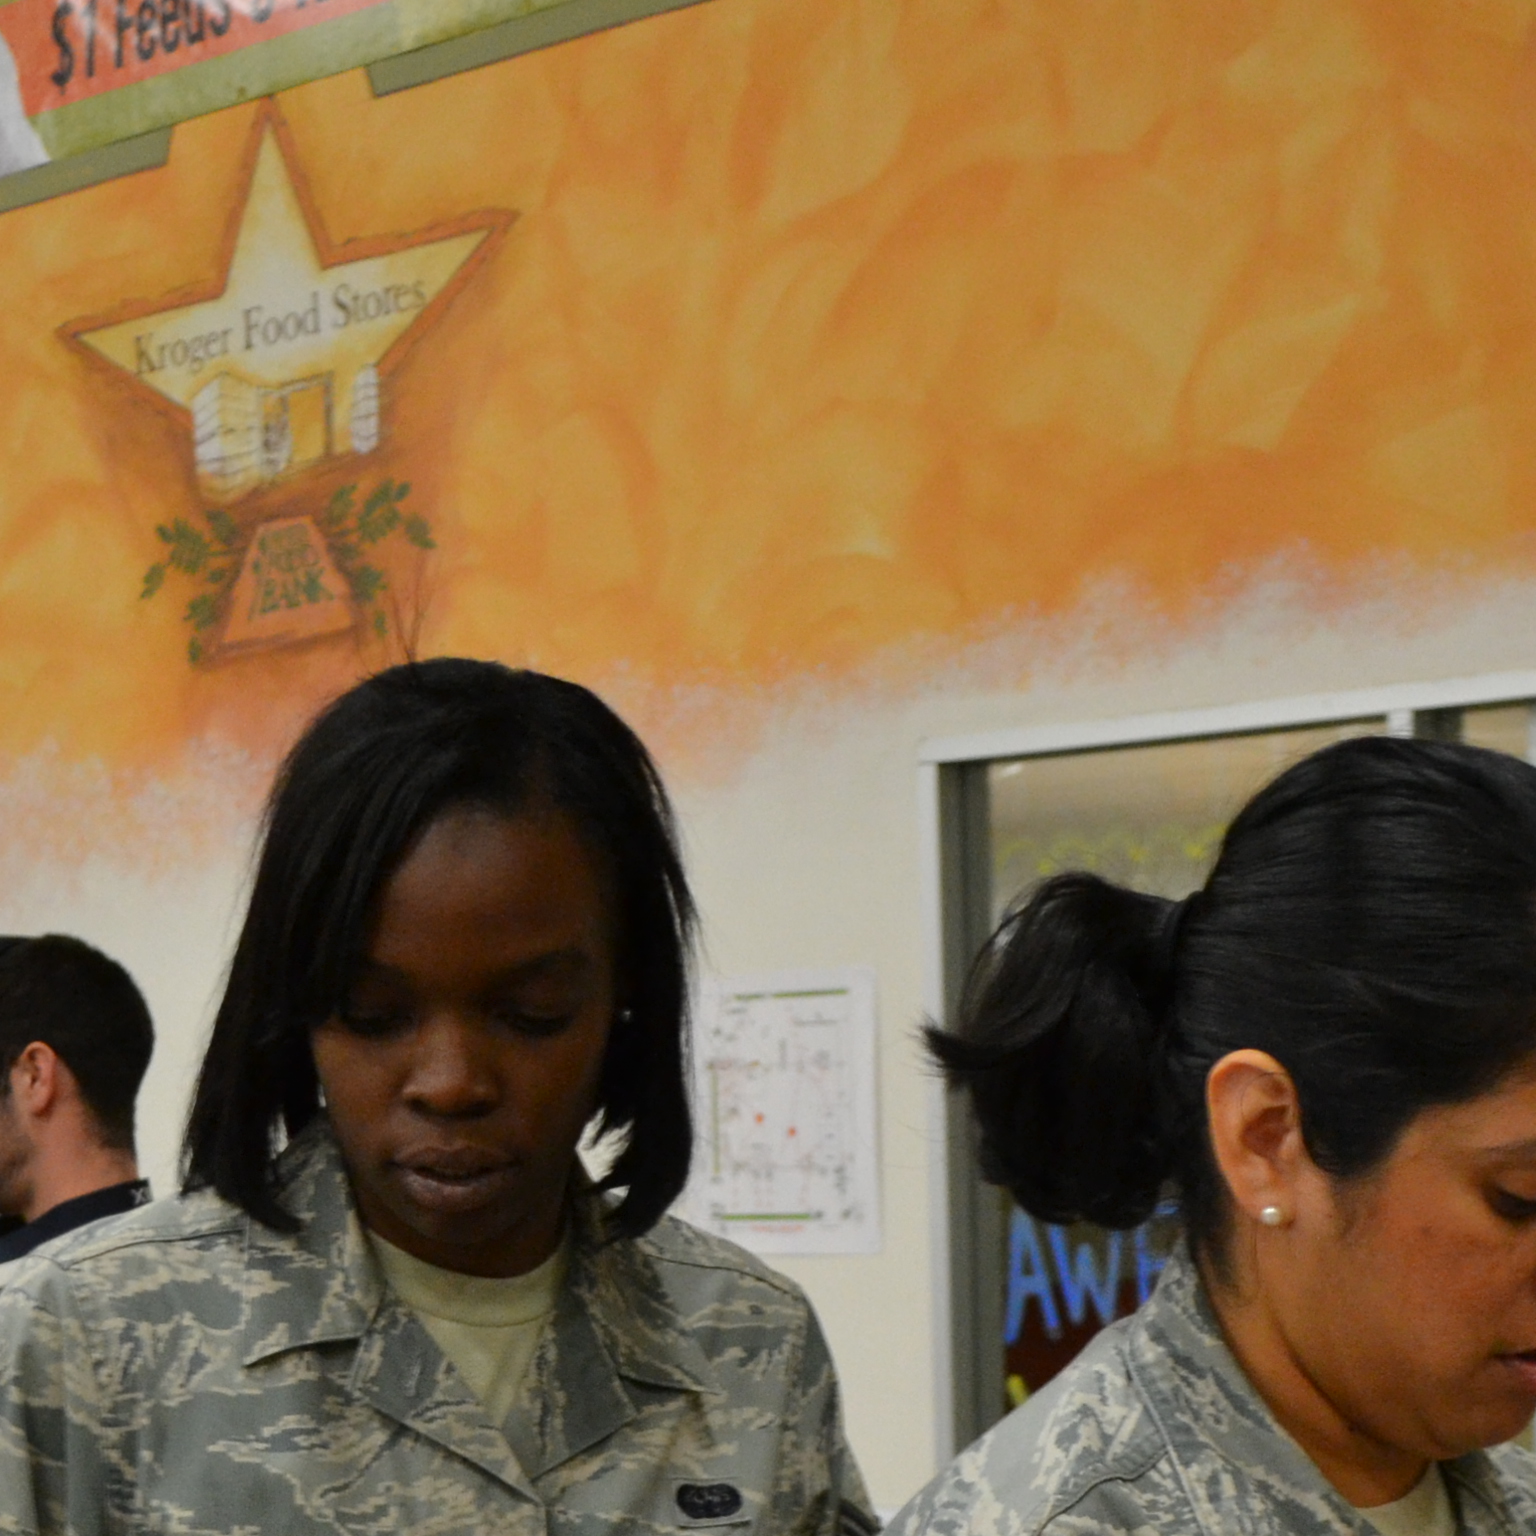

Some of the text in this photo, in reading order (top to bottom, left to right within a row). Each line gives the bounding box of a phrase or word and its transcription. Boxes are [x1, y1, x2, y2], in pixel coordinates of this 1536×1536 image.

[133, 278, 427, 377] Kroger Food Stores
